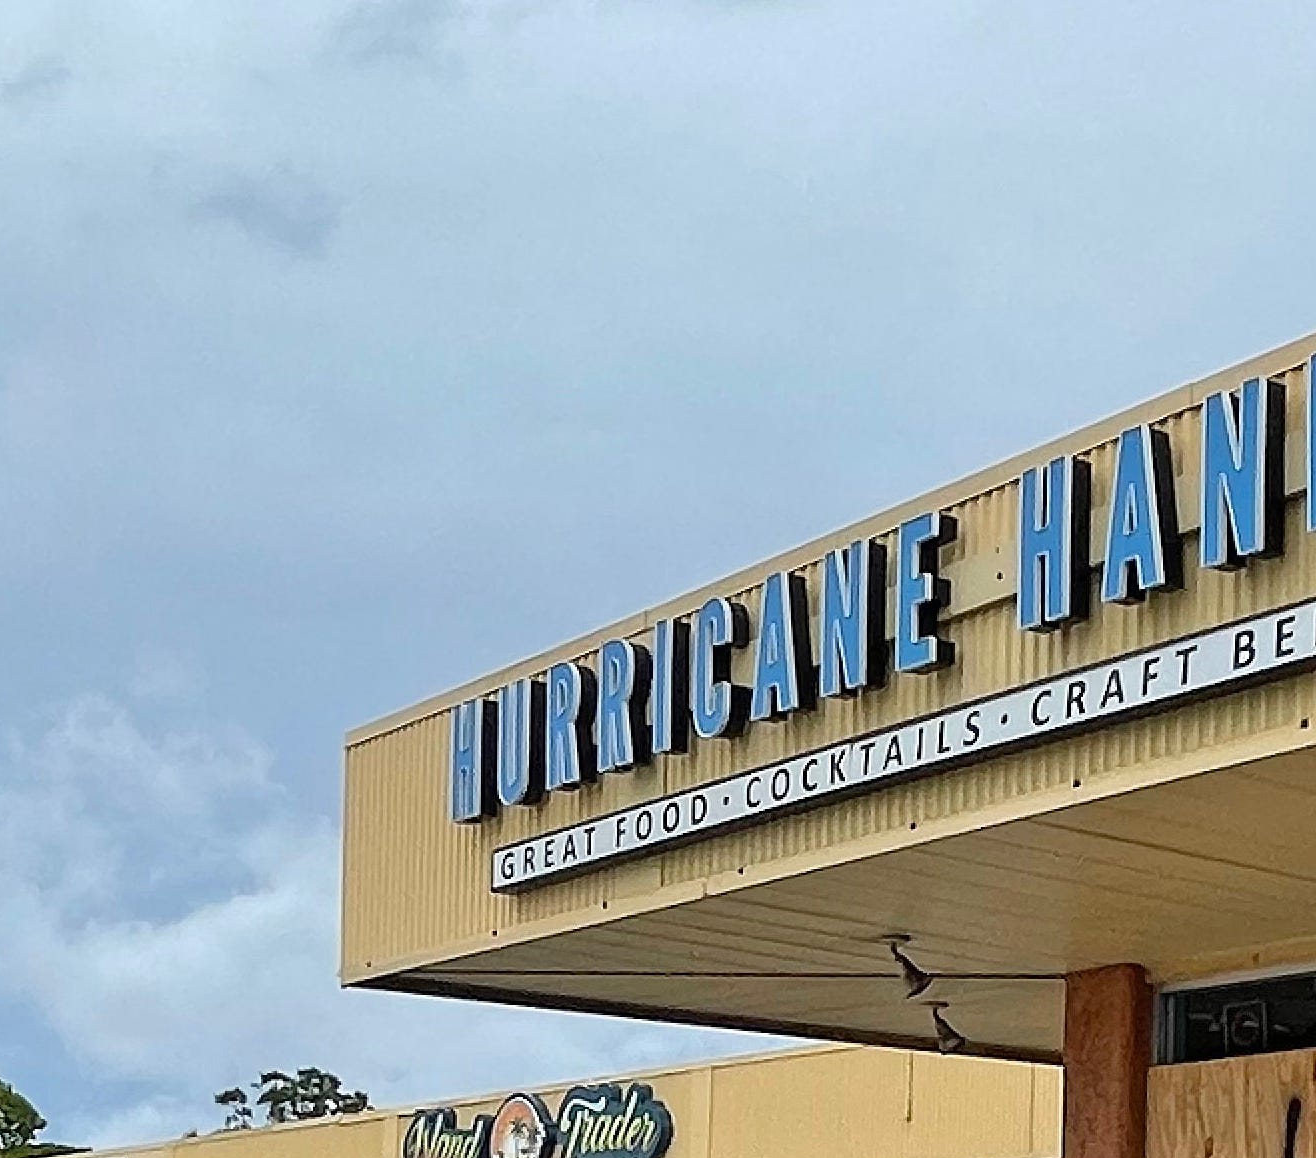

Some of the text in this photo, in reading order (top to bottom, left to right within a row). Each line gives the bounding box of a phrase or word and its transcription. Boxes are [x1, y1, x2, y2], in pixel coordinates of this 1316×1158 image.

[449, 512, 940, 822] HURRICANE
[499, 825, 596, 880] GREAT
[615, 795, 709, 848] FOOD
[745, 708, 981, 809] COCKTAILS
[1030, 647, 1200, 727] CRAFT
